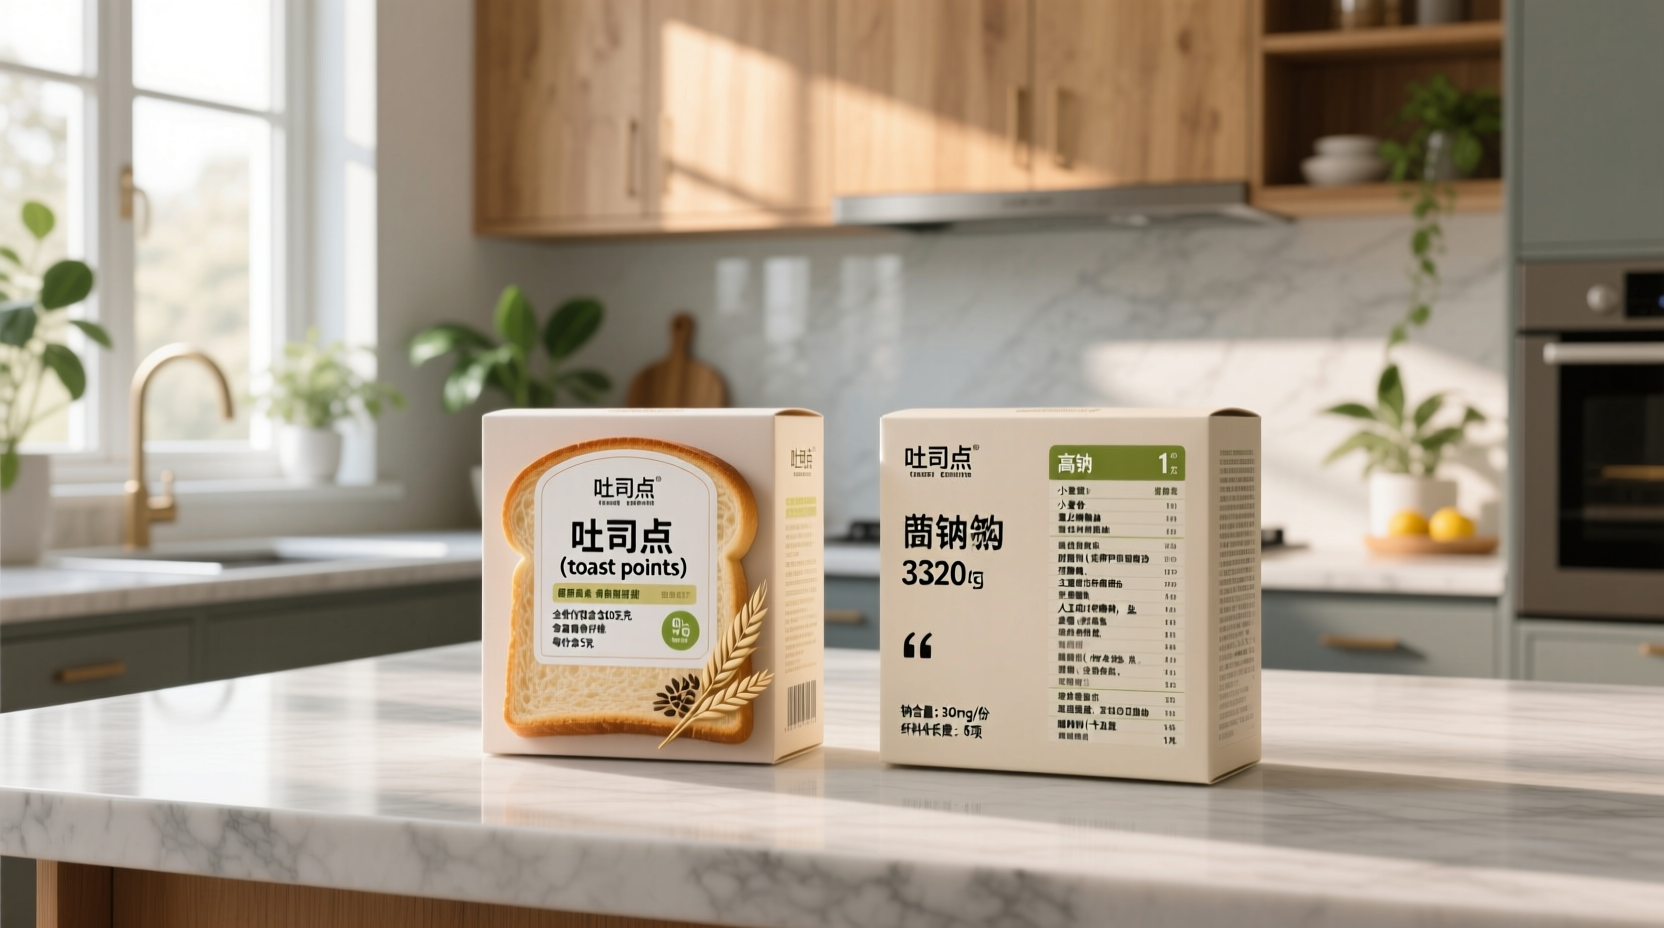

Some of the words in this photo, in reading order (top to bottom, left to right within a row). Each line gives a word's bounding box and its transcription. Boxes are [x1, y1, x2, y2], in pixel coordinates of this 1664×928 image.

[905, 445, 972, 470] 吐司点
[594, 477, 654, 499] 吐司点
[572, 518, 673, 554] 吐司点
[560, 556, 616, 578] (toast
[621, 557, 687, 580] points)
